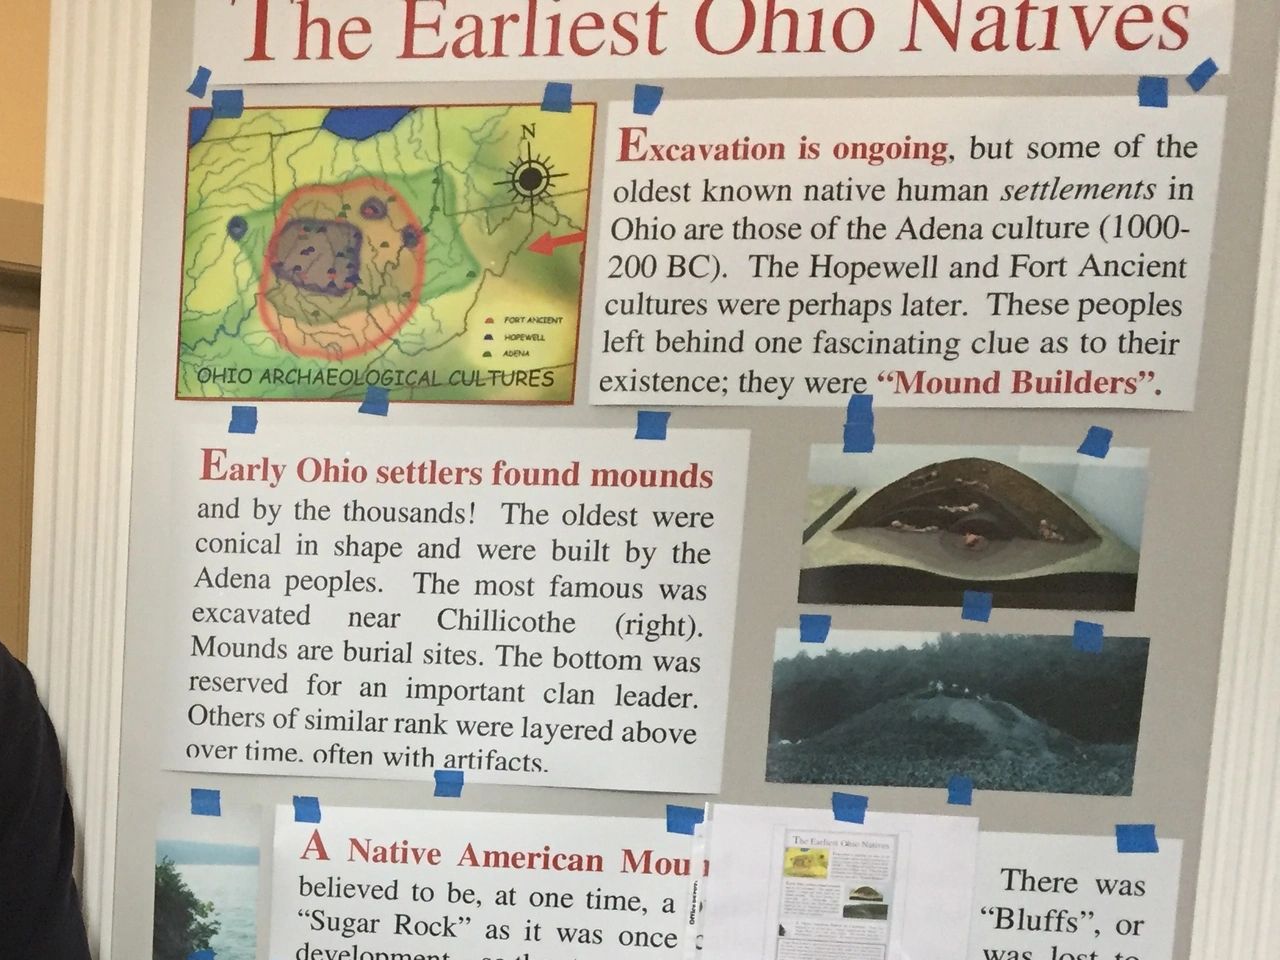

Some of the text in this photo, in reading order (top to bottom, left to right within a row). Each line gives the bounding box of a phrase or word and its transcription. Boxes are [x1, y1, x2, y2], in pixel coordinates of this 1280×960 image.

[232, 0, 1190, 61] The Earliest Ohio Natives
[521, 123, 536, 140] N
[616, 127, 1198, 166] Excavation is ongoing, but some of the
[612, 214, 1190, 243] Ohio are those of the Adena culture (1000-
[197, 367, 555, 387] OHIO ARCHAEOLOGICAL CULTURES
[600, 368, 1161, 400] existence; they were “Mound Builders”.
[200, 448, 712, 488] Early Ohio settlers found mounds
[198, 497, 714, 528] and by the thousands! The oldest were
[192, 604, 702, 642] excavated near Chillicothe (right).
[300, 829, 330, 860] A
[348, 838, 441, 865] Native
[457, 841, 603, 872] American
[1000, 868, 1078, 894] There
[1096, 879, 1146, 896] was
[298, 909, 677, 948] “Sugar Rock” as it was once
[981, 906, 1145, 938] “Bluffs”, or
